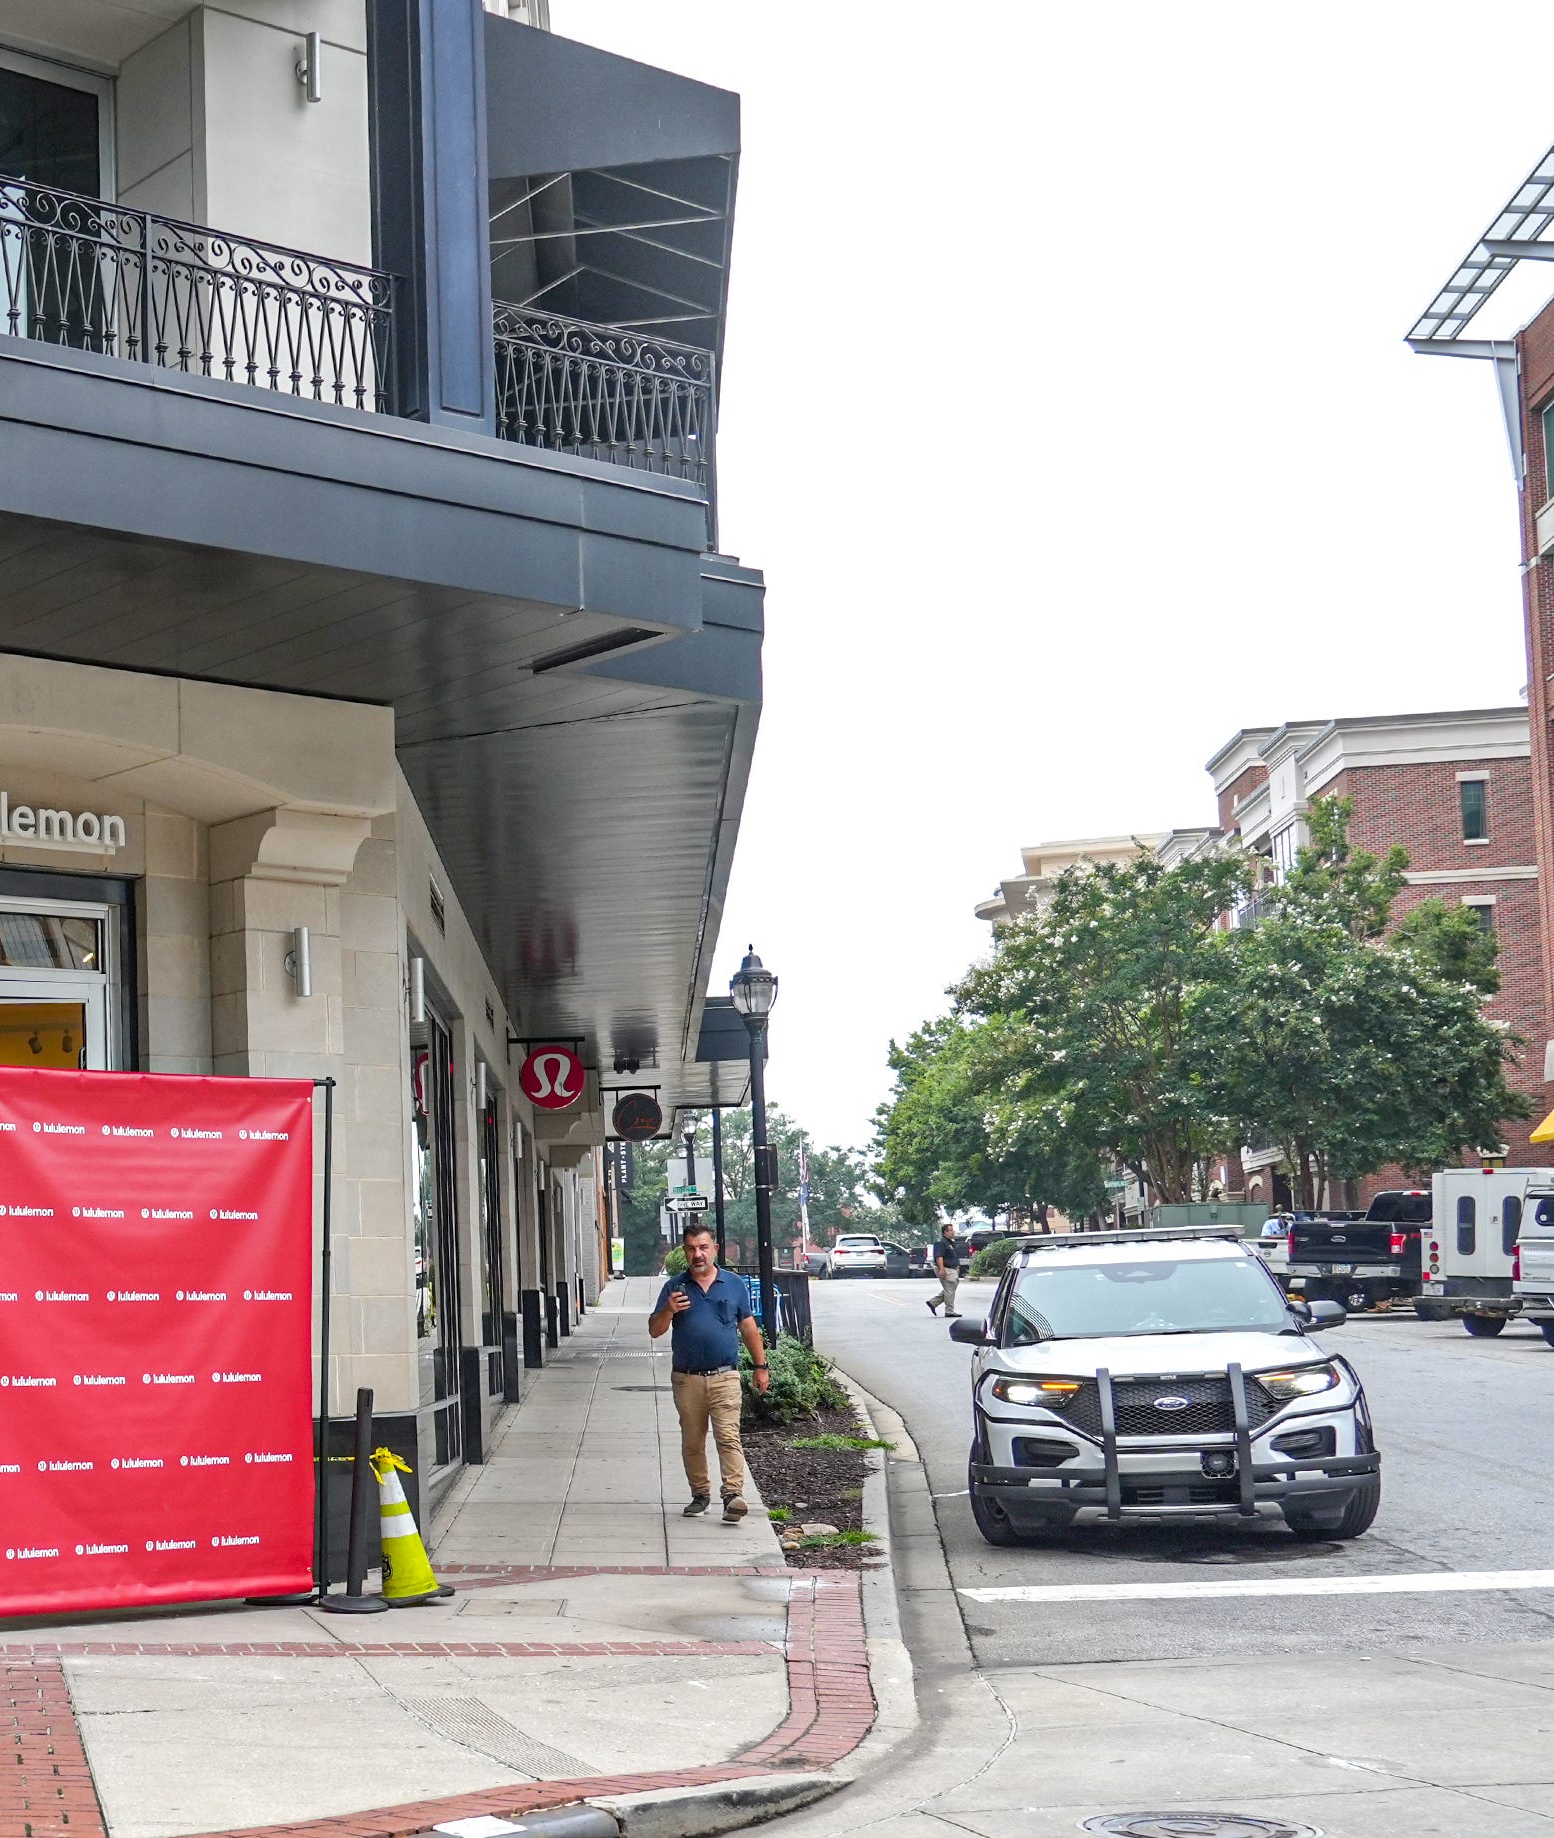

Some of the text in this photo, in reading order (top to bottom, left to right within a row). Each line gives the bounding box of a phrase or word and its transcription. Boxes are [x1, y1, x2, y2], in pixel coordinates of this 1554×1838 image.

[43, 1122, 86, 1135] lululemon
[112, 1125, 154, 1138] lululemon
[180, 1127, 223, 1140] lululemon
[248, 1129, 289, 1141] lululemon
[8, 1205, 54, 1217] lululemon
[82, 1206, 125, 1219] lululemon
[151, 1208, 194, 1220] lululemon
[219, 1209, 259, 1220] lululemon
[45, 1290, 90, 1302] lululemon
[117, 1290, 160, 1302] lululemon
[185, 1290, 227, 1301] lululemon
[253, 1290, 293, 1301] lululemon
[11, 1375, 57, 1387] lululemon
[83, 1374, 126, 1386] lululemon
[152, 1373, 195, 1384] lululemon
[222, 1371, 262, 1383] lululemon
[49, 1460, 94, 1471] lululemon
[121, 1457, 164, 1469] lululemon
[190, 1455, 230, 1466] lululemon
[254, 1452, 293, 1463] lululemon
[17, 1547, 60, 1560] lululemon
[85, 1543, 129, 1555] lululemon
[155, 1539, 196, 1551] lululemon
[221, 1535, 260, 1547] lululemon
